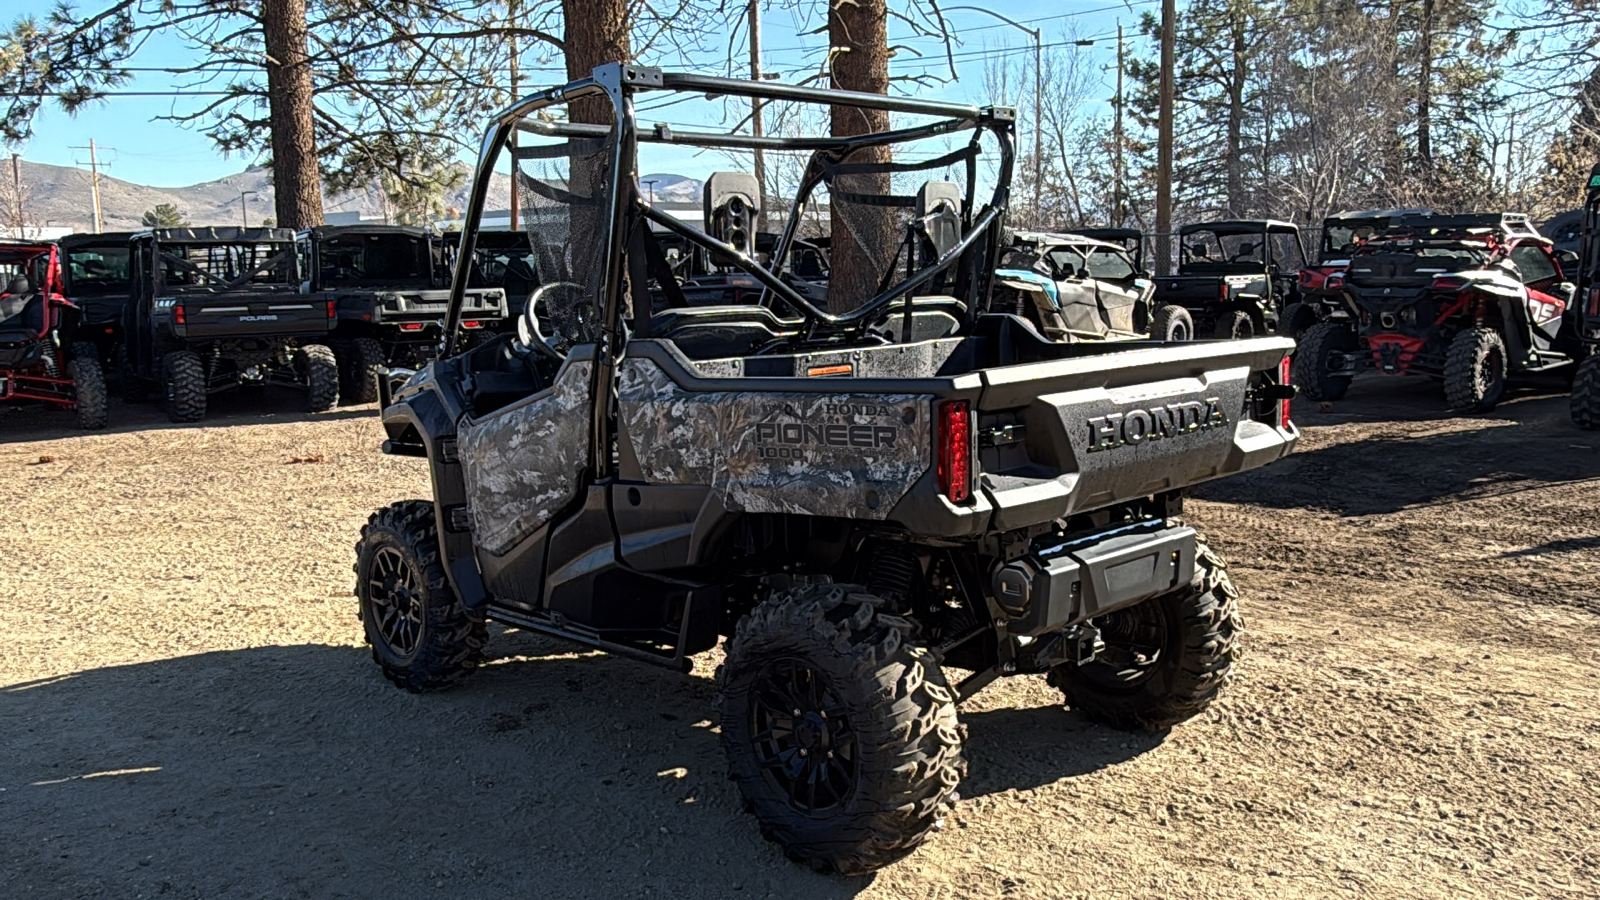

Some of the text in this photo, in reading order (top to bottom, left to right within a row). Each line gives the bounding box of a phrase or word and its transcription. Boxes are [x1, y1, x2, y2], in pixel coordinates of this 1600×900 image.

[826, 404, 890, 416] HONDA
[1086, 397, 1230, 453] HONDA
[756, 423, 898, 448] PIONEER
[757, 447, 804, 459] 1000
